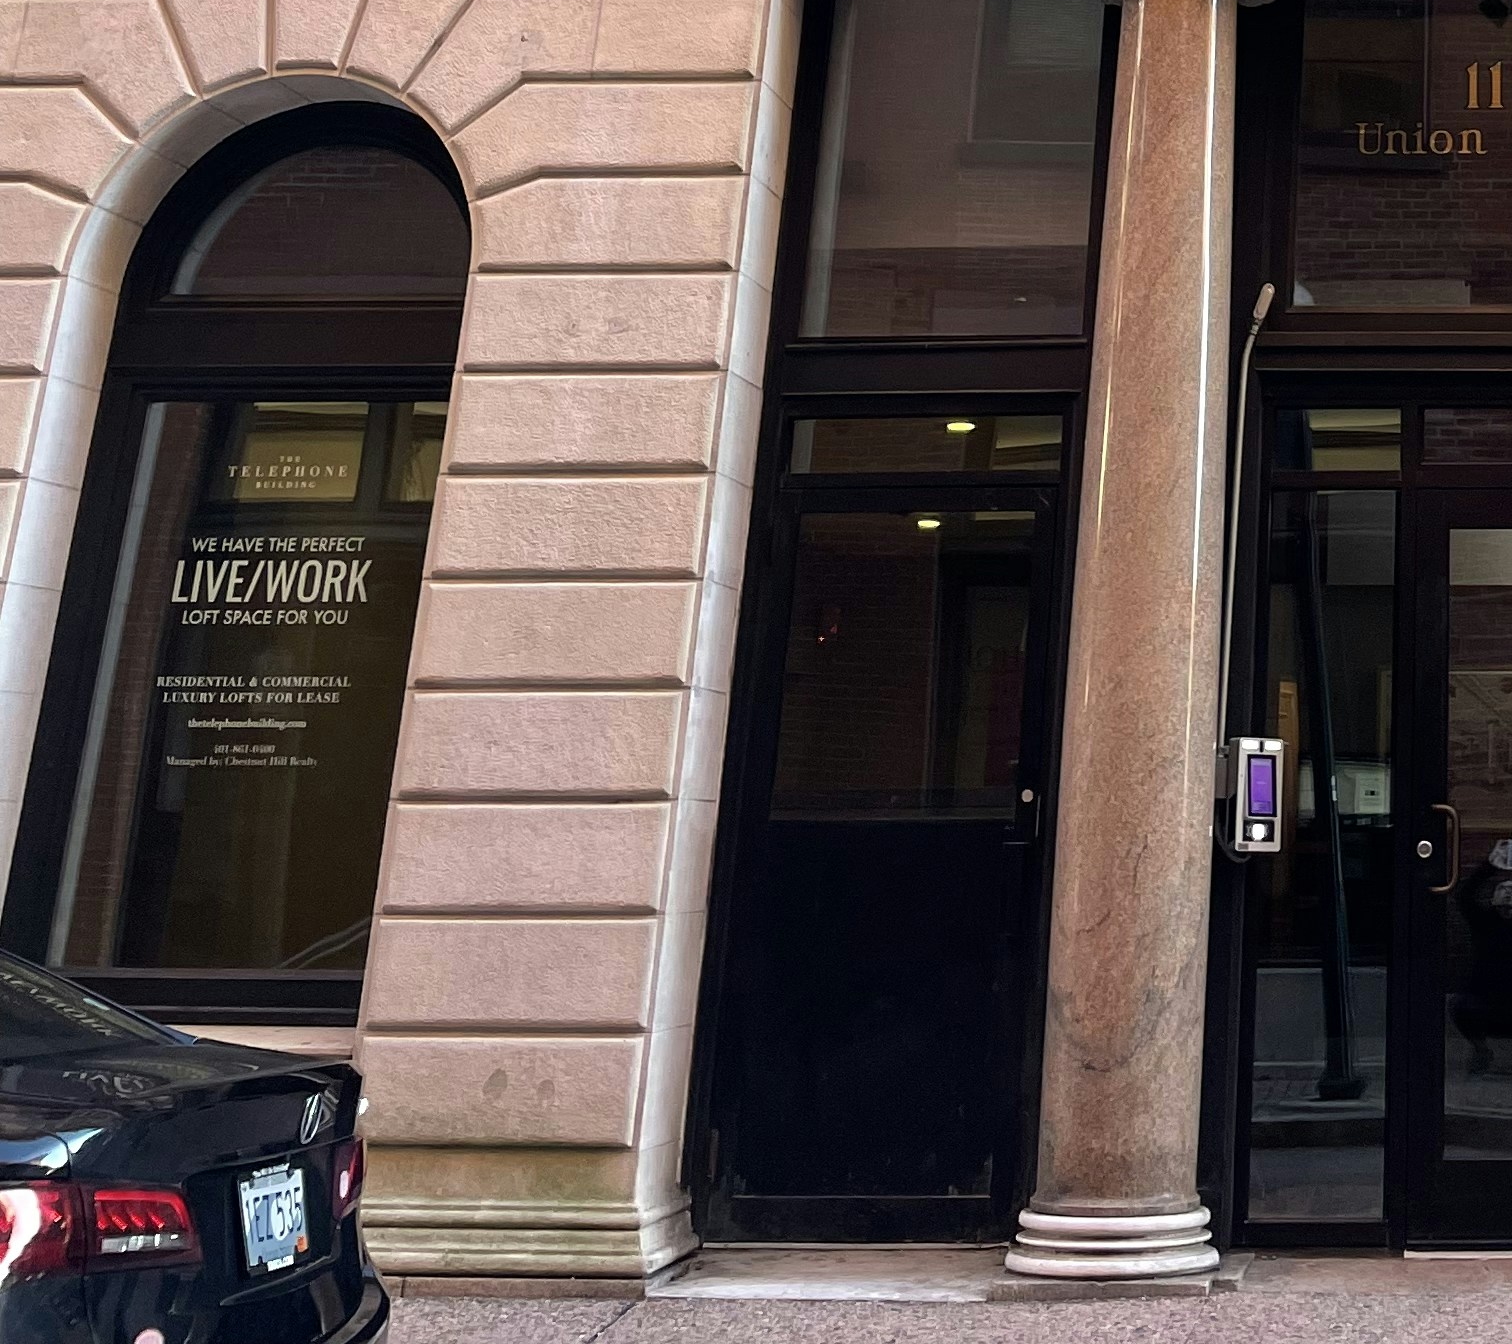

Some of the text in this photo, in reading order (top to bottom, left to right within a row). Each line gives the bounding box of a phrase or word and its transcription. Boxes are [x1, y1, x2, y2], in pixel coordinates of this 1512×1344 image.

[1355, 121, 1489, 155] Union
[228, 464, 349, 478] TELEPHONE
[255, 481, 317, 490] BUILDING
[192, 537, 366, 552] WE HAVE THE PERFECT
[171, 559, 373, 603] LIVE/WORK
[181, 610, 349, 625] LOFT SPACE FOR YOU
[156, 676, 351, 688] RESIDENTIAL & COMMERCIAL
[162, 691, 340, 704] LUXURY LOFTS FOR LEASE
[276, 1187, 303, 1236] 535
